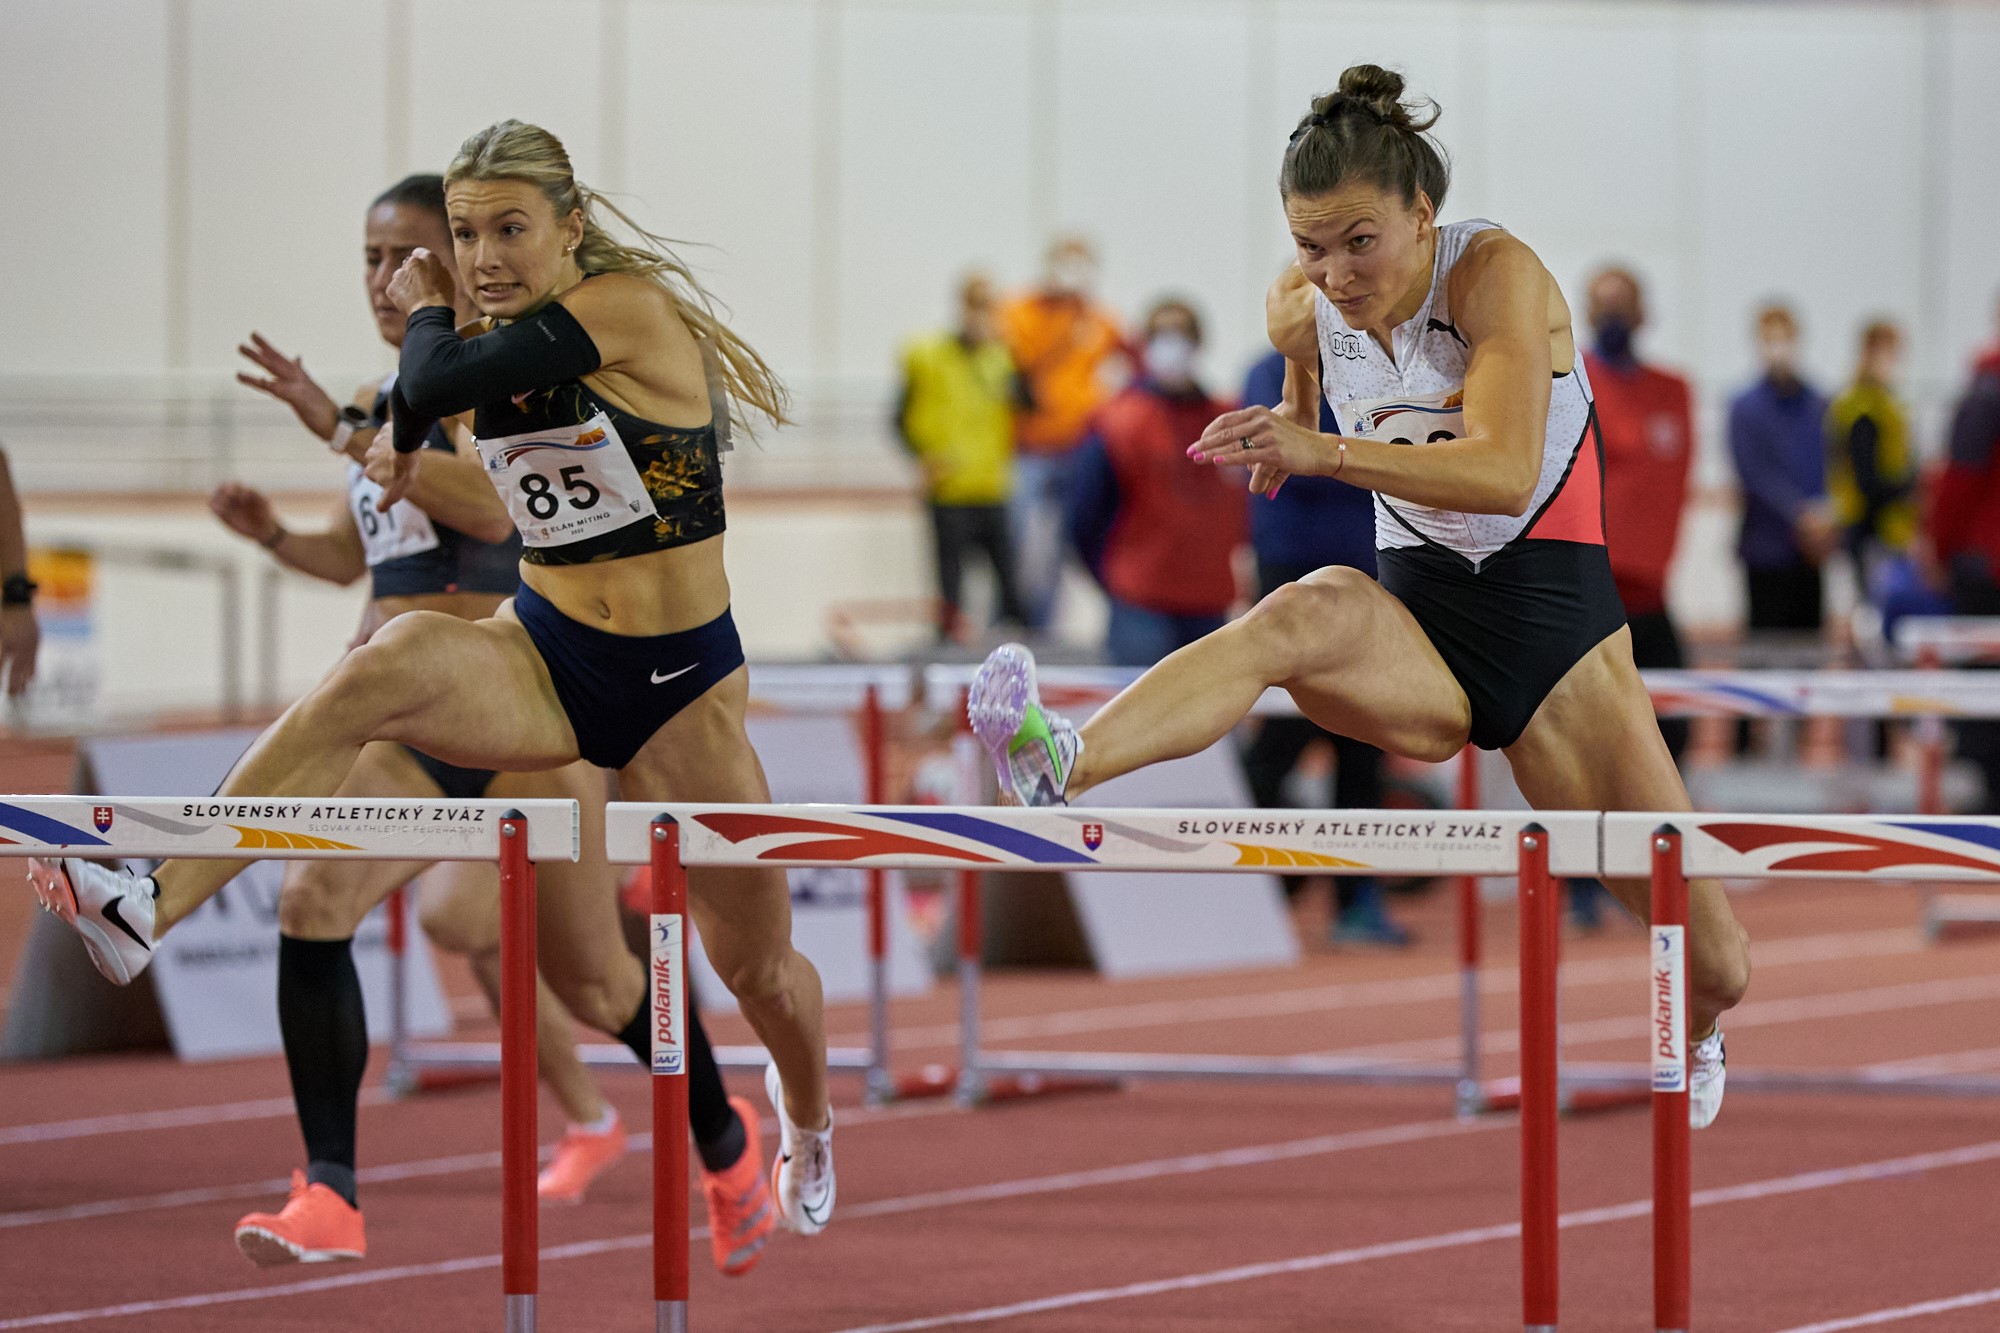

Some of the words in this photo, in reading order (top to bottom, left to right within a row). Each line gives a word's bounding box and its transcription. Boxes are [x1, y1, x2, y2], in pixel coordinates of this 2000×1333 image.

[520, 465, 600, 520] 85
[183, 803, 301, 818] SLOVENSKÝ
[311, 805, 424, 821] ATLETICKÝ
[308, 824, 350, 832] SLOVAK
[356, 825, 408, 833] ATHLETIC
[1178, 820, 1305, 836] SLOVENSKÝ
[1315, 821, 1436, 837] ATLETICKÝ
[653, 956, 677, 1045] polanik
[1655, 968, 1677, 1059] polanik
[655, 1055, 679, 1064] IAAF
